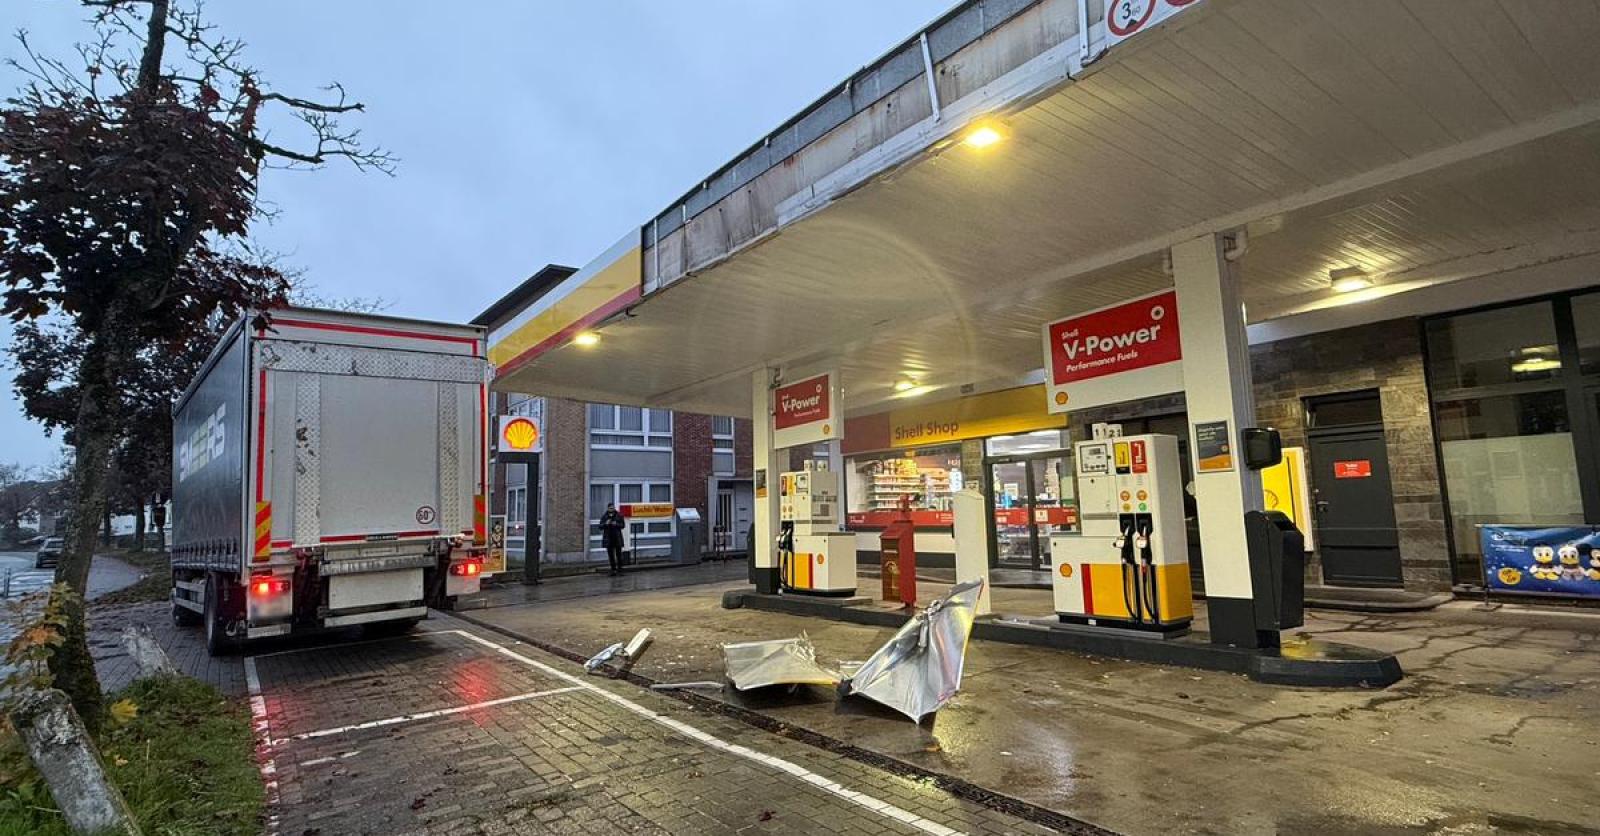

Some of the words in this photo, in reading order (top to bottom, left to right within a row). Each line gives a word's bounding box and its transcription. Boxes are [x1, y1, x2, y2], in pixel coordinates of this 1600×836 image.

[1062, 324, 1161, 360] V-Power
[1066, 356, 1116, 373] Performance
[1117, 350, 1138, 362] Fuels
[782, 395, 820, 413] V-Power
[895, 424, 923, 440] Shell
[927, 420, 960, 436] Shop
